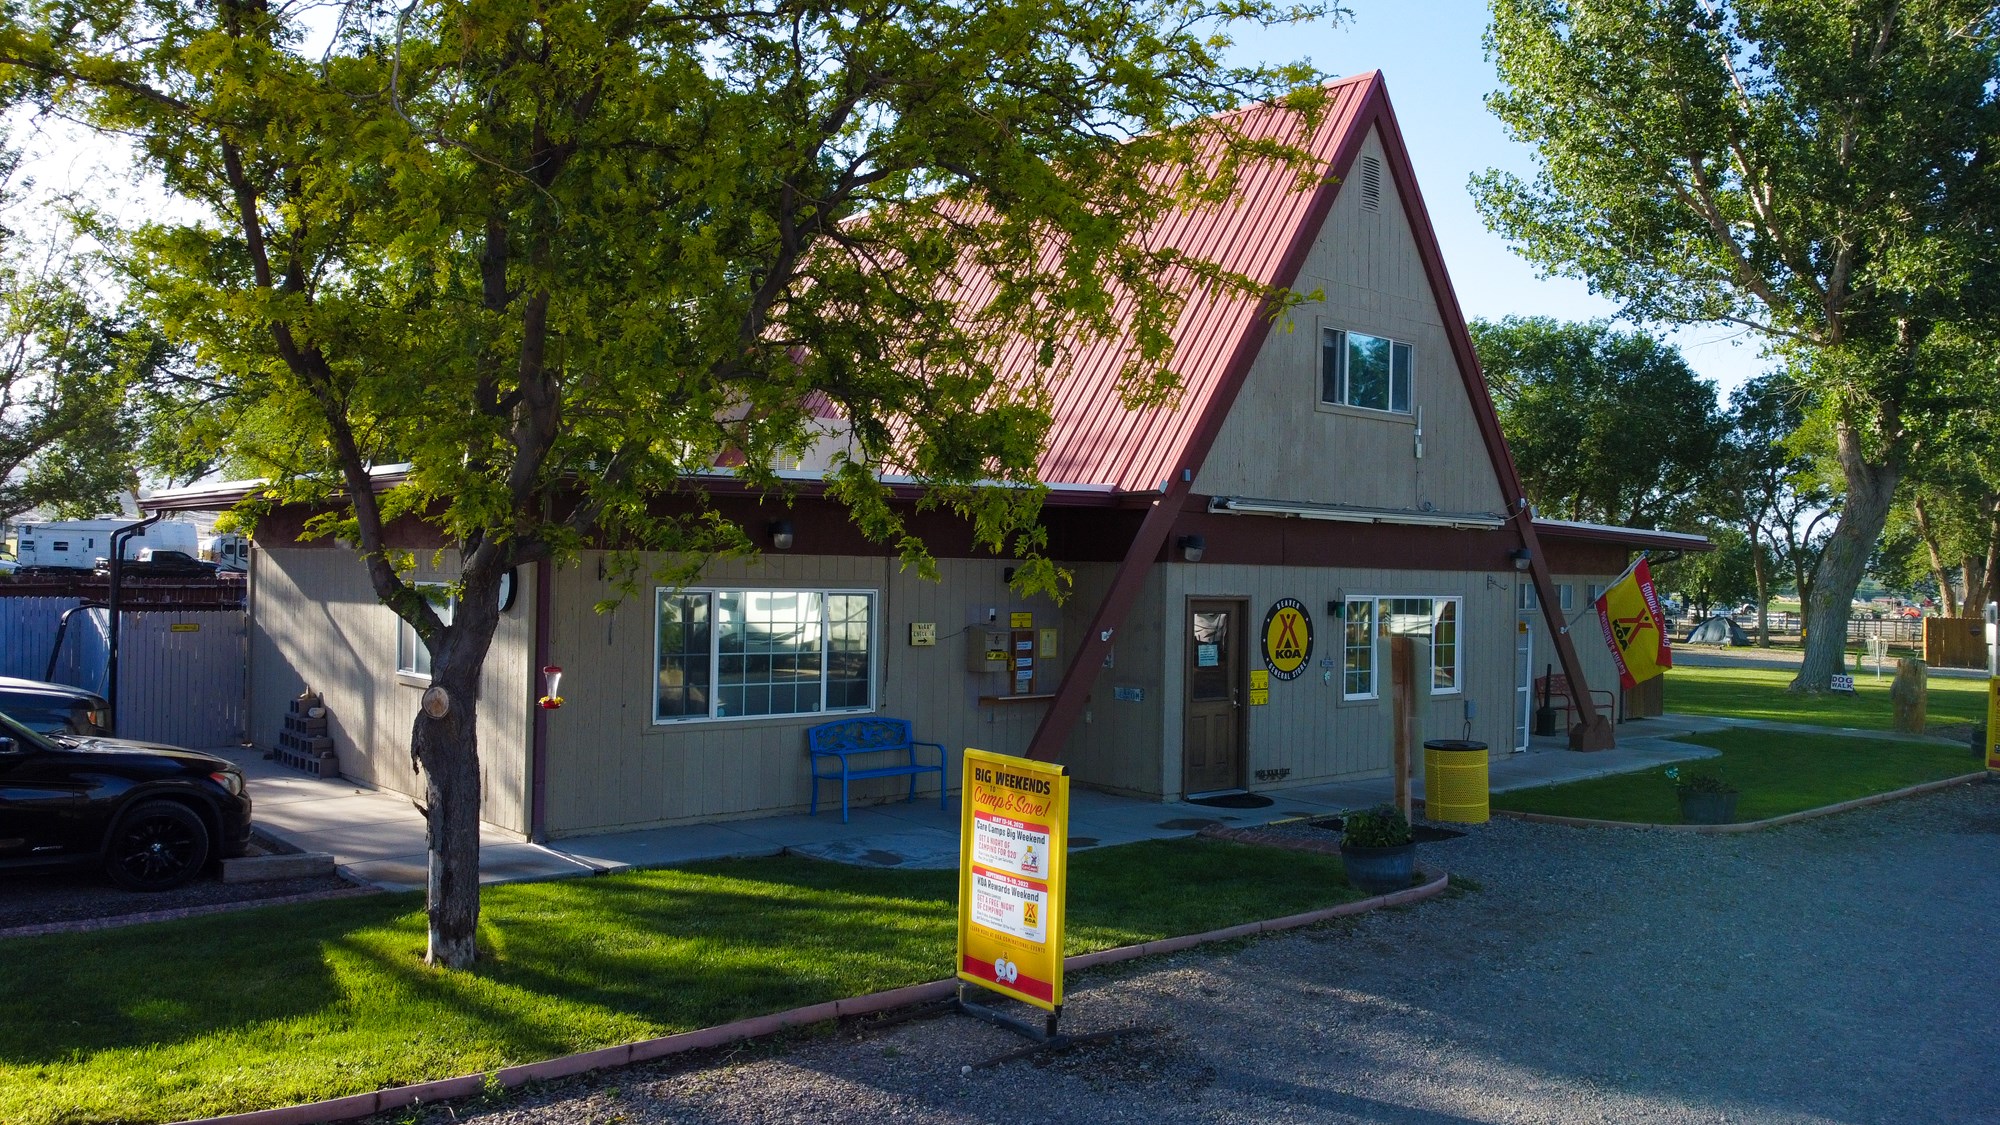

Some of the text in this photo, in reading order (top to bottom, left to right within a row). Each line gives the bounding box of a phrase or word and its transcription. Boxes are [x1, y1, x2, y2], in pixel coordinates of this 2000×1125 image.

[1276, 599, 1300, 610] BEAVER
[1612, 619, 1629, 651] KOA
[1275, 649, 1302, 659] KOA
[1612, 650, 1626, 676] AWARD
[1268, 662, 1291, 680] GENERAL
[1292, 660, 1307, 678] STORE
[1832, 676, 1853, 684] DOG
[975, 768, 1051, 795] BIG WEEKENDS
[974, 786, 1051, 817] Camp & Save!
[976, 820, 1045, 844] Care Camps Big Weekend
[978, 842, 996, 854] CAMPING
[997, 847, 1006, 857] FOR
[1004, 840, 1010, 849] OF
[977, 876, 987, 888] KOA
[988, 881, 1010, 894] Rewards
[1011, 885, 1039, 902] Weekend
[977, 893, 985, 902] GET
[989, 897, 999, 908] FREE
[1001, 902, 1015, 912] NIGHT
[977, 901, 982, 910] OF
